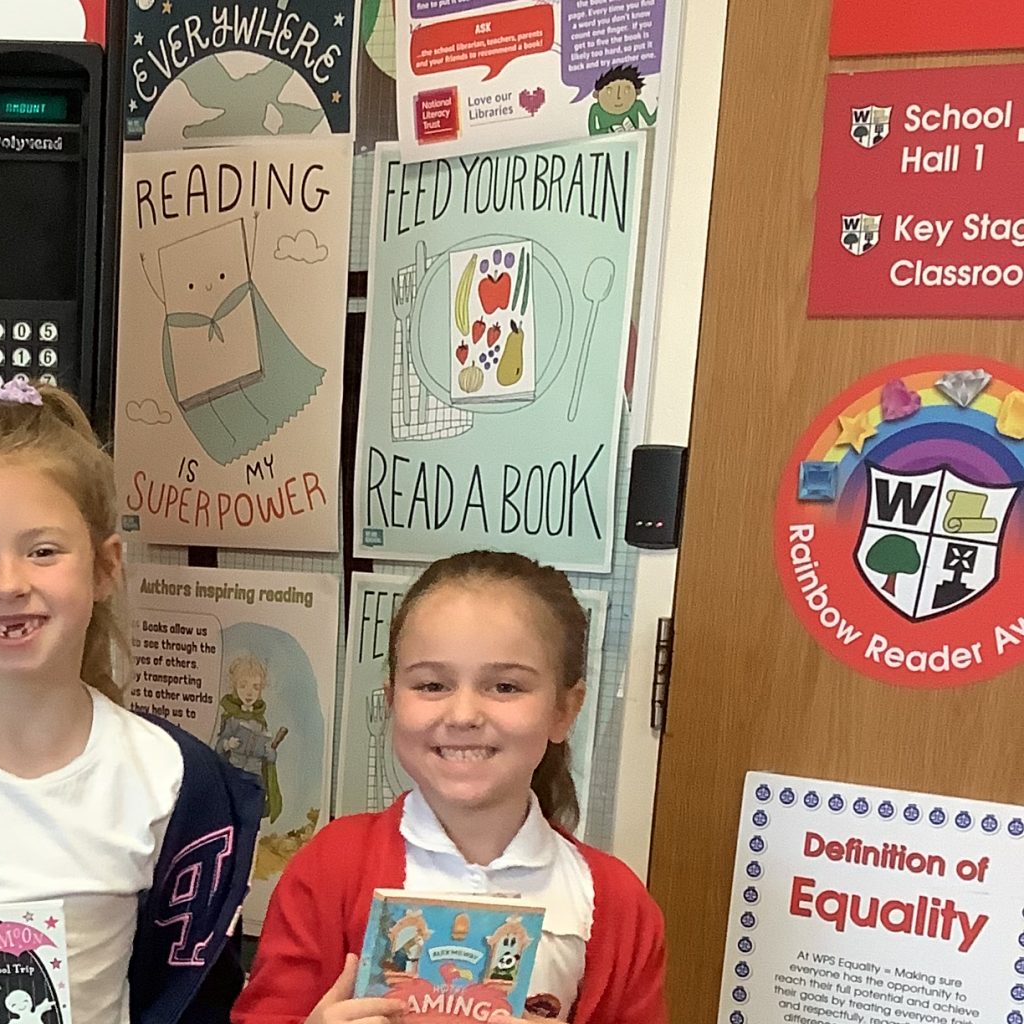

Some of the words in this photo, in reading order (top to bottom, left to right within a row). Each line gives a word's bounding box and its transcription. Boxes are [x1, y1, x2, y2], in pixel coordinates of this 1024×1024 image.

[475, 22, 492, 34] ASK
[132, 4, 342, 102] EVERYWHERE
[5, 103, 46, 113] AMOUNT
[422, 97, 452, 110] National
[467, 96, 492, 107] Love
[495, 92, 513, 103] our
[469, 105, 514, 121] Libraries
[422, 108, 451, 121] Literacy
[423, 120, 441, 130] Trust
[903, 100, 1013, 133] School
[900, 144, 960, 173] Hall
[974, 144, 984, 171] 1
[136, 160, 330, 229] READING
[383, 156, 451, 242] FEED
[460, 155, 527, 214] YOUR
[532, 151, 630, 234] BRAIN
[893, 214, 954, 247] Key
[962, 213, 1024, 248] Stag
[889, 259, 1024, 288] Classroo
[44, 325, 52, 338] 5
[44, 350, 52, 364] 6
[178, 457, 199, 483] IS
[246, 453, 275, 485] MY
[366, 446, 454, 531] READ
[461, 465, 495, 533] A
[501, 444, 604, 540] BOOK
[875, 479, 937, 526] W
[140, 577, 192, 597] Authors
[195, 580, 255, 605] inspiring
[259, 586, 314, 609] reading
[788, 523, 863, 647] Rainbow
[864, 632, 984, 673] Reader
[142, 620, 168, 634] Books
[170, 622, 194, 636] allow
[196, 626, 208, 637] us
[143, 639, 159, 650] see
[161, 639, 198, 654] through
[200, 642, 216, 654] the
[153, 654, 164, 667] of
[144, 671, 202, 688] transporting
[144, 687, 154, 698] to
[155, 688, 180, 700] other
[182, 691, 213, 704] worlds
[151, 703, 170, 718] help
[172, 707, 183, 718] us
[186, 707, 196, 719] to
[803, 831, 946, 878] Definition
[956, 856, 990, 883] of
[789, 876, 989, 954] Equality
[12, 963, 36, 977] Trip
[789, 963, 840, 982] everyone
[843, 971, 863, 985] has
[865, 975, 885, 989] the
[887, 980, 952, 1001] opportunity
[954, 990, 967, 1003] to
[796, 950, 810, 962] At
[812, 952, 836, 967] WPS
[838, 957, 881, 975] Equality
[894, 967, 936, 986] Making
[939, 977, 963, 989] sure
[408, 993, 511, 1022] AMING
[775, 973, 806, 988] reach
[809, 978, 833, 992] their
[836, 983, 852, 996] full
[854, 987, 904, 1005] potential
[906, 996, 930, 1010] and
[933, 1001, 980, 1019] achieve
